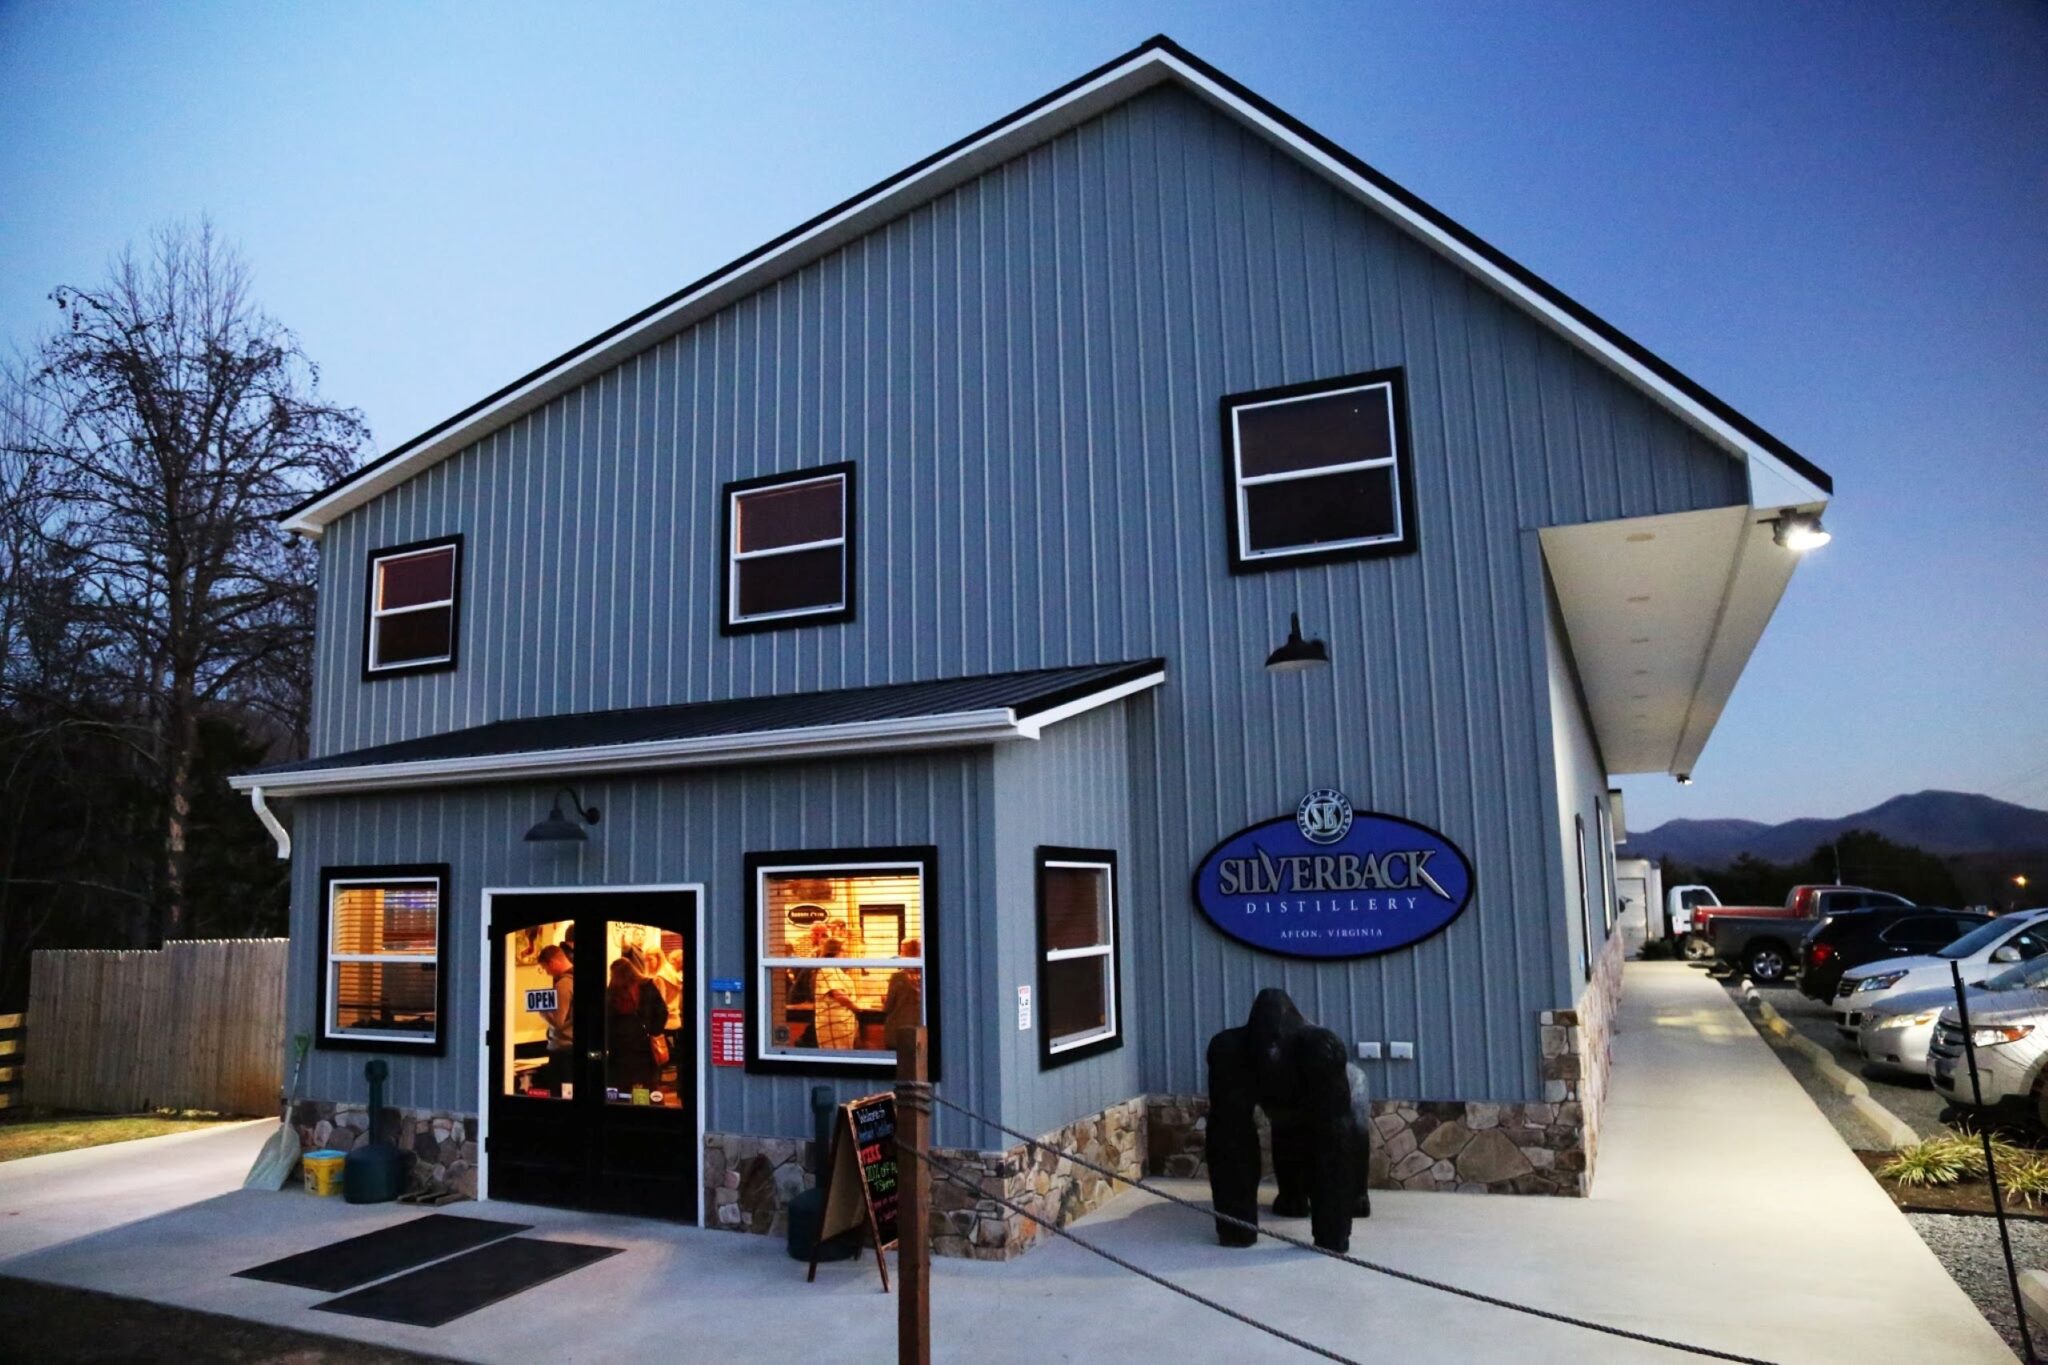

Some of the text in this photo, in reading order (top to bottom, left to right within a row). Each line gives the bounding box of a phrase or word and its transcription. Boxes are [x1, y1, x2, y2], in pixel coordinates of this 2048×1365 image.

[1310, 802, 1338, 830] SB
[1219, 842, 1451, 900] SILVERBACK
[1246, 897, 1417, 914] DISTILLERY
[1327, 928, 1383, 937] VIRGINIA
[527, 991, 555, 1010] OPEN
